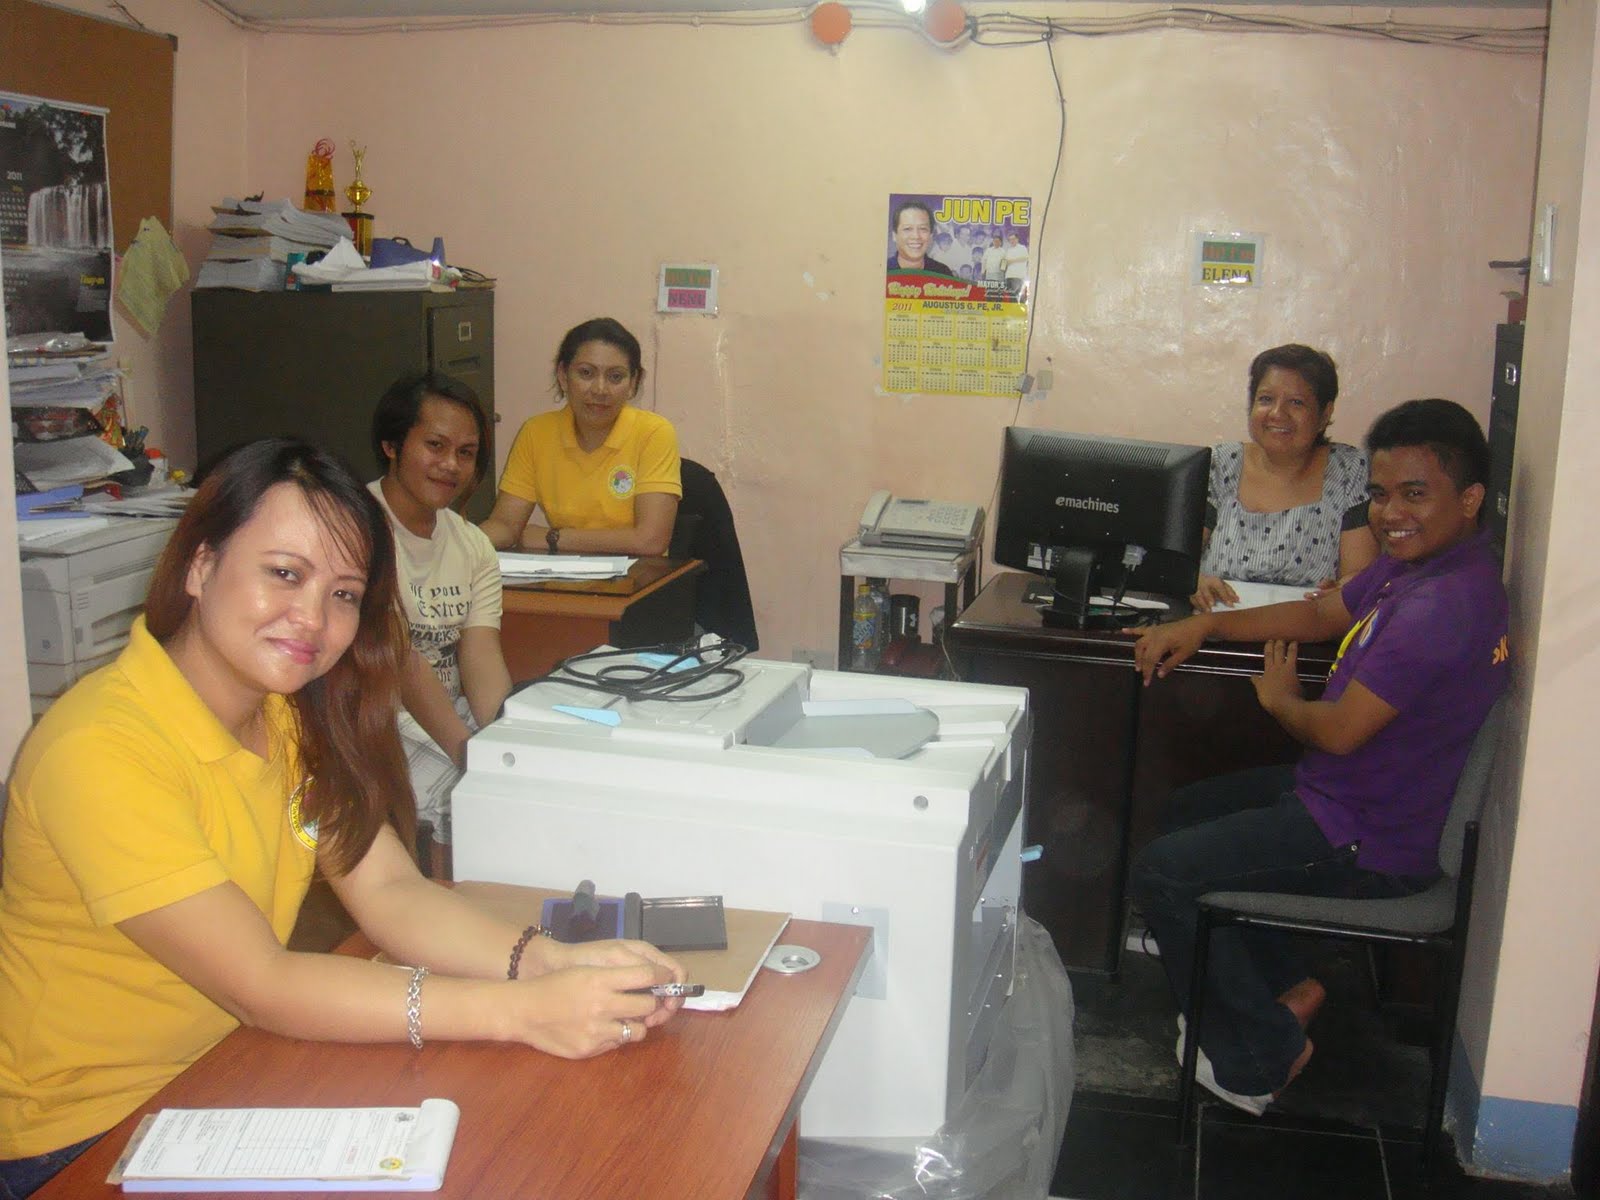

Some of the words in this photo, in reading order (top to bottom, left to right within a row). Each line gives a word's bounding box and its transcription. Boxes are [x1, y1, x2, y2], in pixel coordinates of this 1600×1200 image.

[934, 197, 992, 225] JUN
[994, 198, 1030, 226] PE
[891, 302, 913, 311] 2011
[922, 300, 965, 310] AUGUSTUS
[1055, 496, 1120, 514] emachines
[430, 585, 461, 599] you
